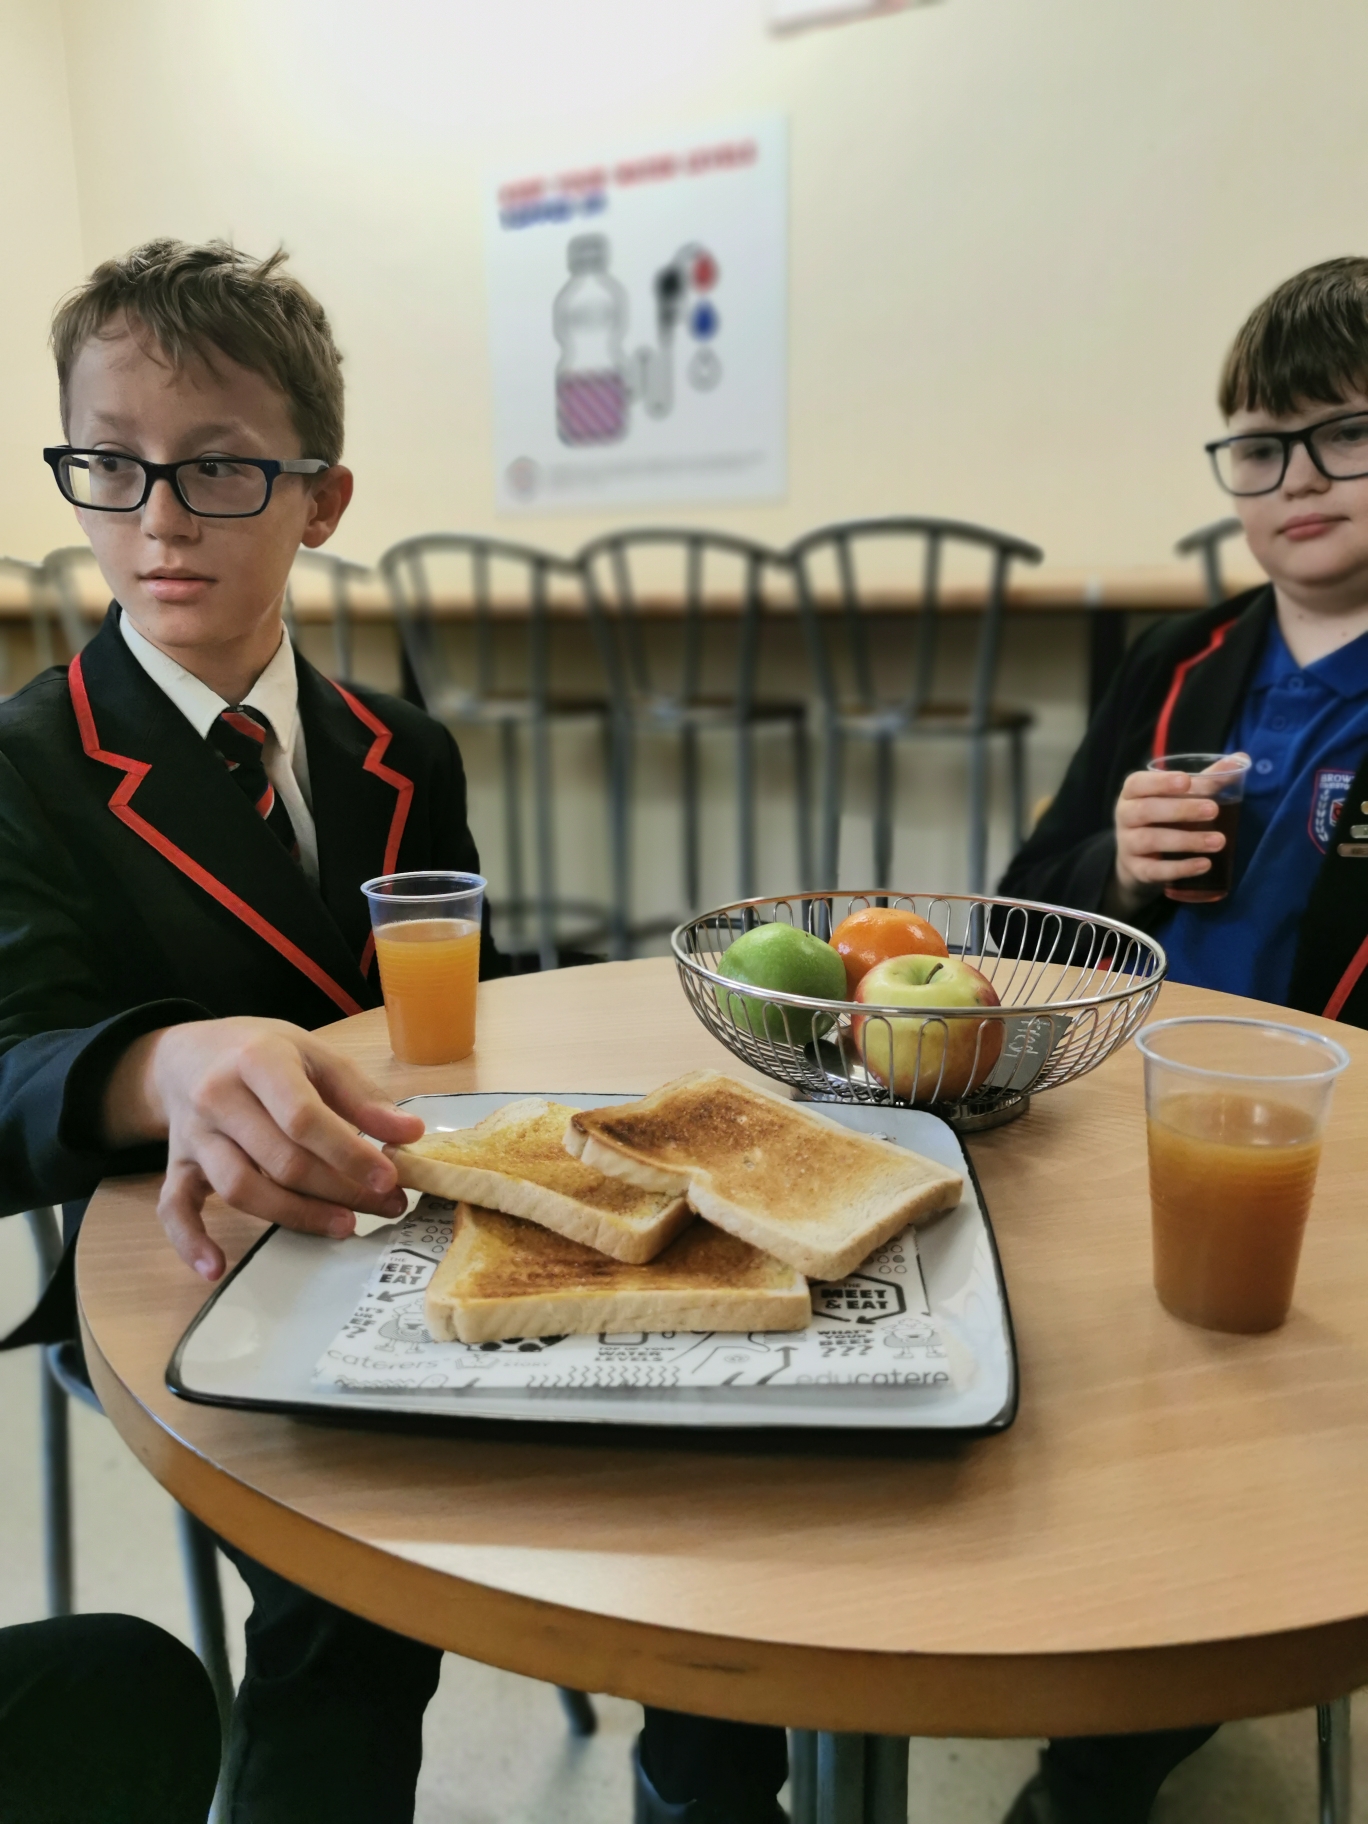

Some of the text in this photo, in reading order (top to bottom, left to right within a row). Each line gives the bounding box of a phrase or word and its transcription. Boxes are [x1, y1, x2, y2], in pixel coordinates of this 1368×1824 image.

[380, 1263, 428, 1275] EET
[378, 1274, 422, 1285] EAT
[820, 1289, 888, 1299] MEET
[825, 1299, 889, 1310] & EAT
[818, 1338, 875, 1347] BEEF
[327, 1348, 439, 1370] caterers
